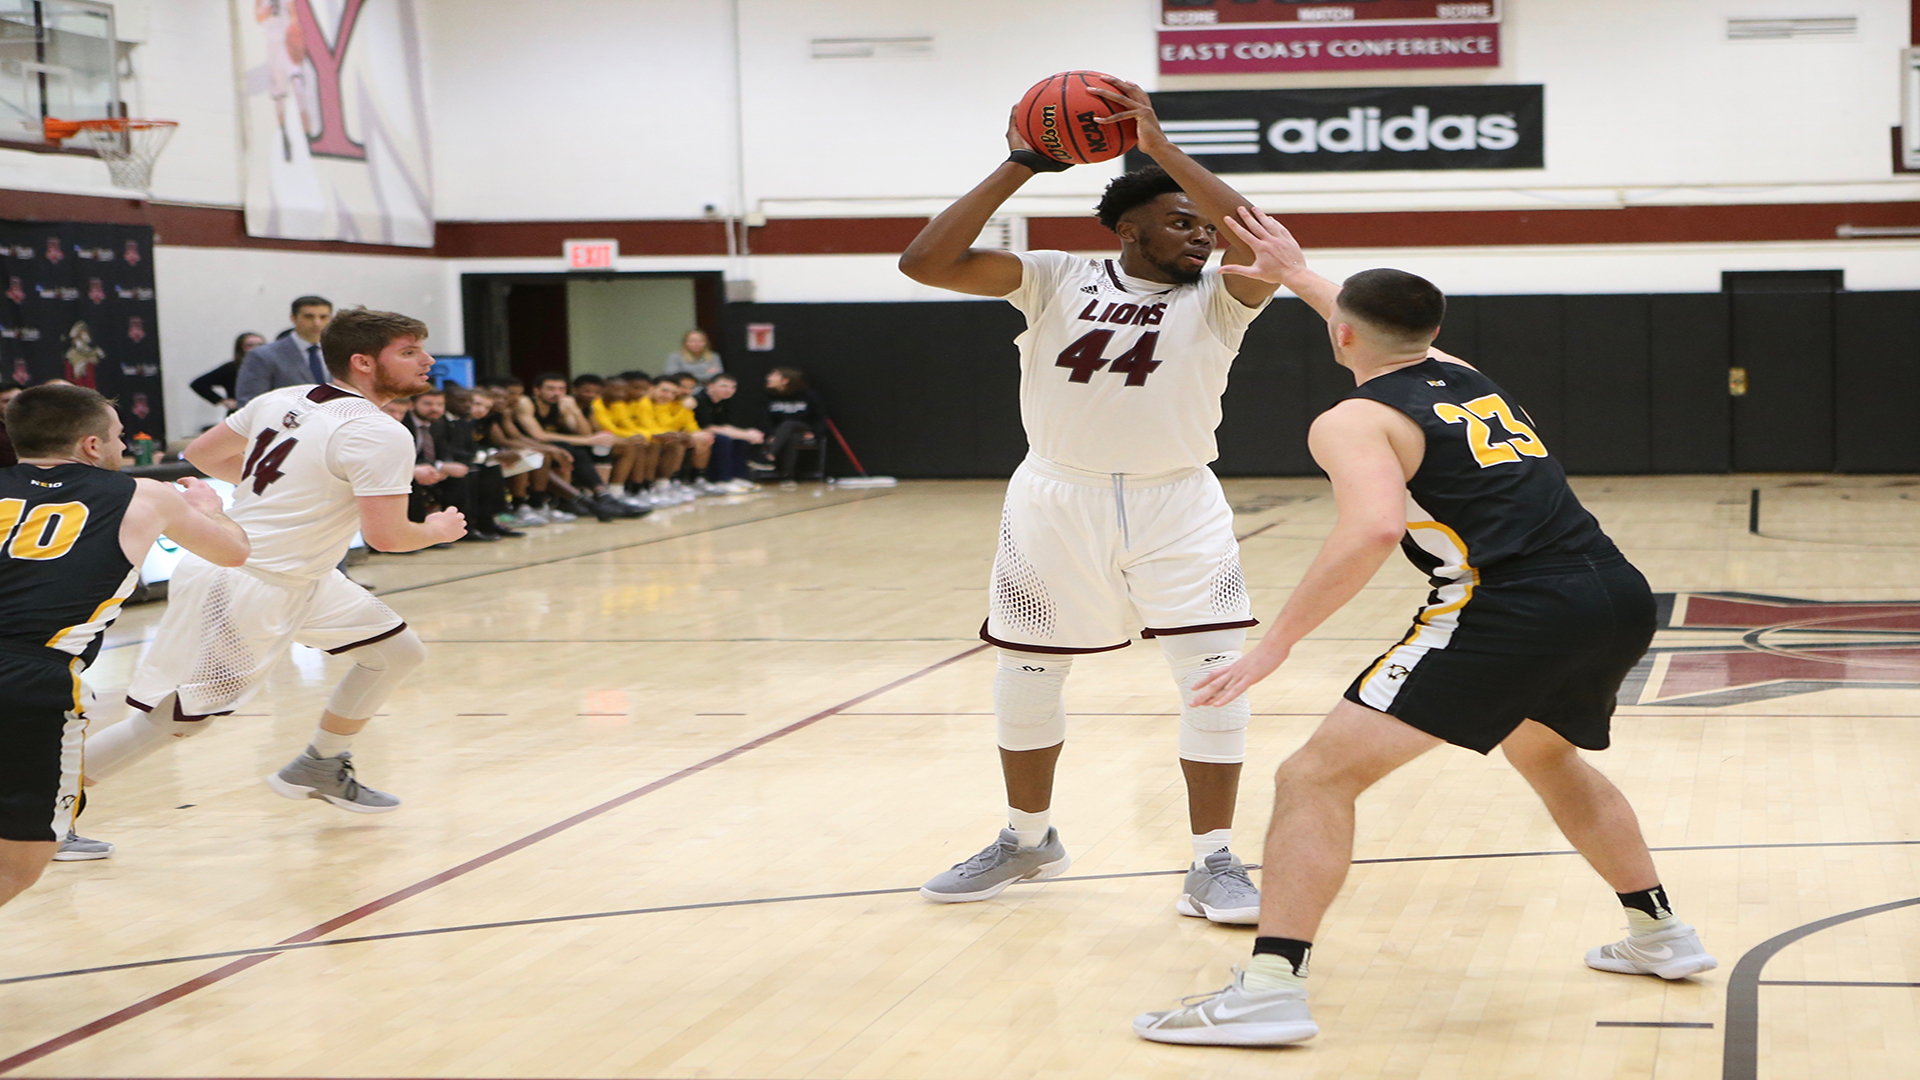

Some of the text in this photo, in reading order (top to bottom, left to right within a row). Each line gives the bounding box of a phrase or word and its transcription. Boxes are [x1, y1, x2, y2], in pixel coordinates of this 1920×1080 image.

[1164, 10, 1219, 25] SCORE
[1297, 7, 1355, 21] MATCH
[1436, 3, 1492, 18] SCORE
[1160, 36, 1493, 61] EAST COAST CONFERENCE
[296, 0, 368, 161] Y
[1077, 110, 1109, 153] NCAA
[1266, 105, 1520, 153] adidas
[571, 244, 611, 268] EXIT
[1078, 298, 1168, 327] LIONS
[1055, 328, 1164, 387] 44
[1432, 392, 1549, 469] 23
[241, 427, 299, 496] 14
